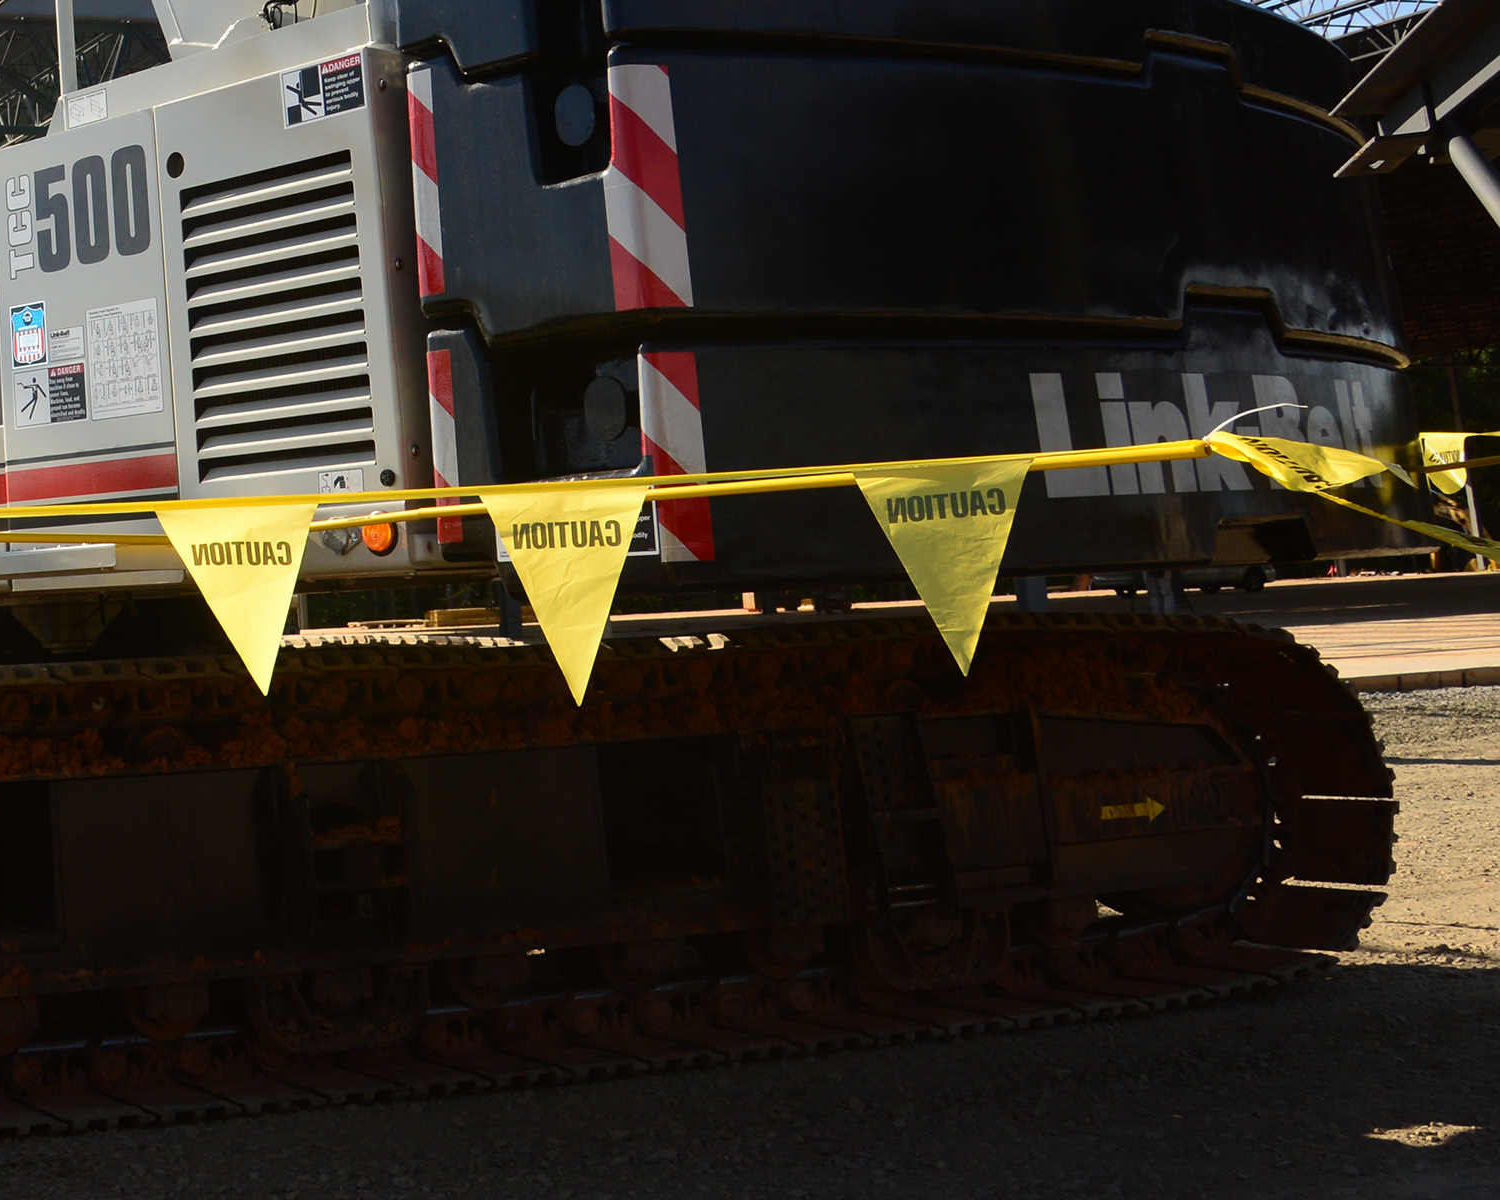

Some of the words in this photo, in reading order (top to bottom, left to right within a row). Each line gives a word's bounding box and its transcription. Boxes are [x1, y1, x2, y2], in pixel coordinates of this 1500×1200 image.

[328, 56, 361, 72] DANGER
[324, 81, 346, 90] swinging
[5, 174, 34, 280] TCC
[33, 144, 151, 273] 500
[57, 365, 81, 376] DANGER
[1029, 372, 1384, 498] Link-Belt
